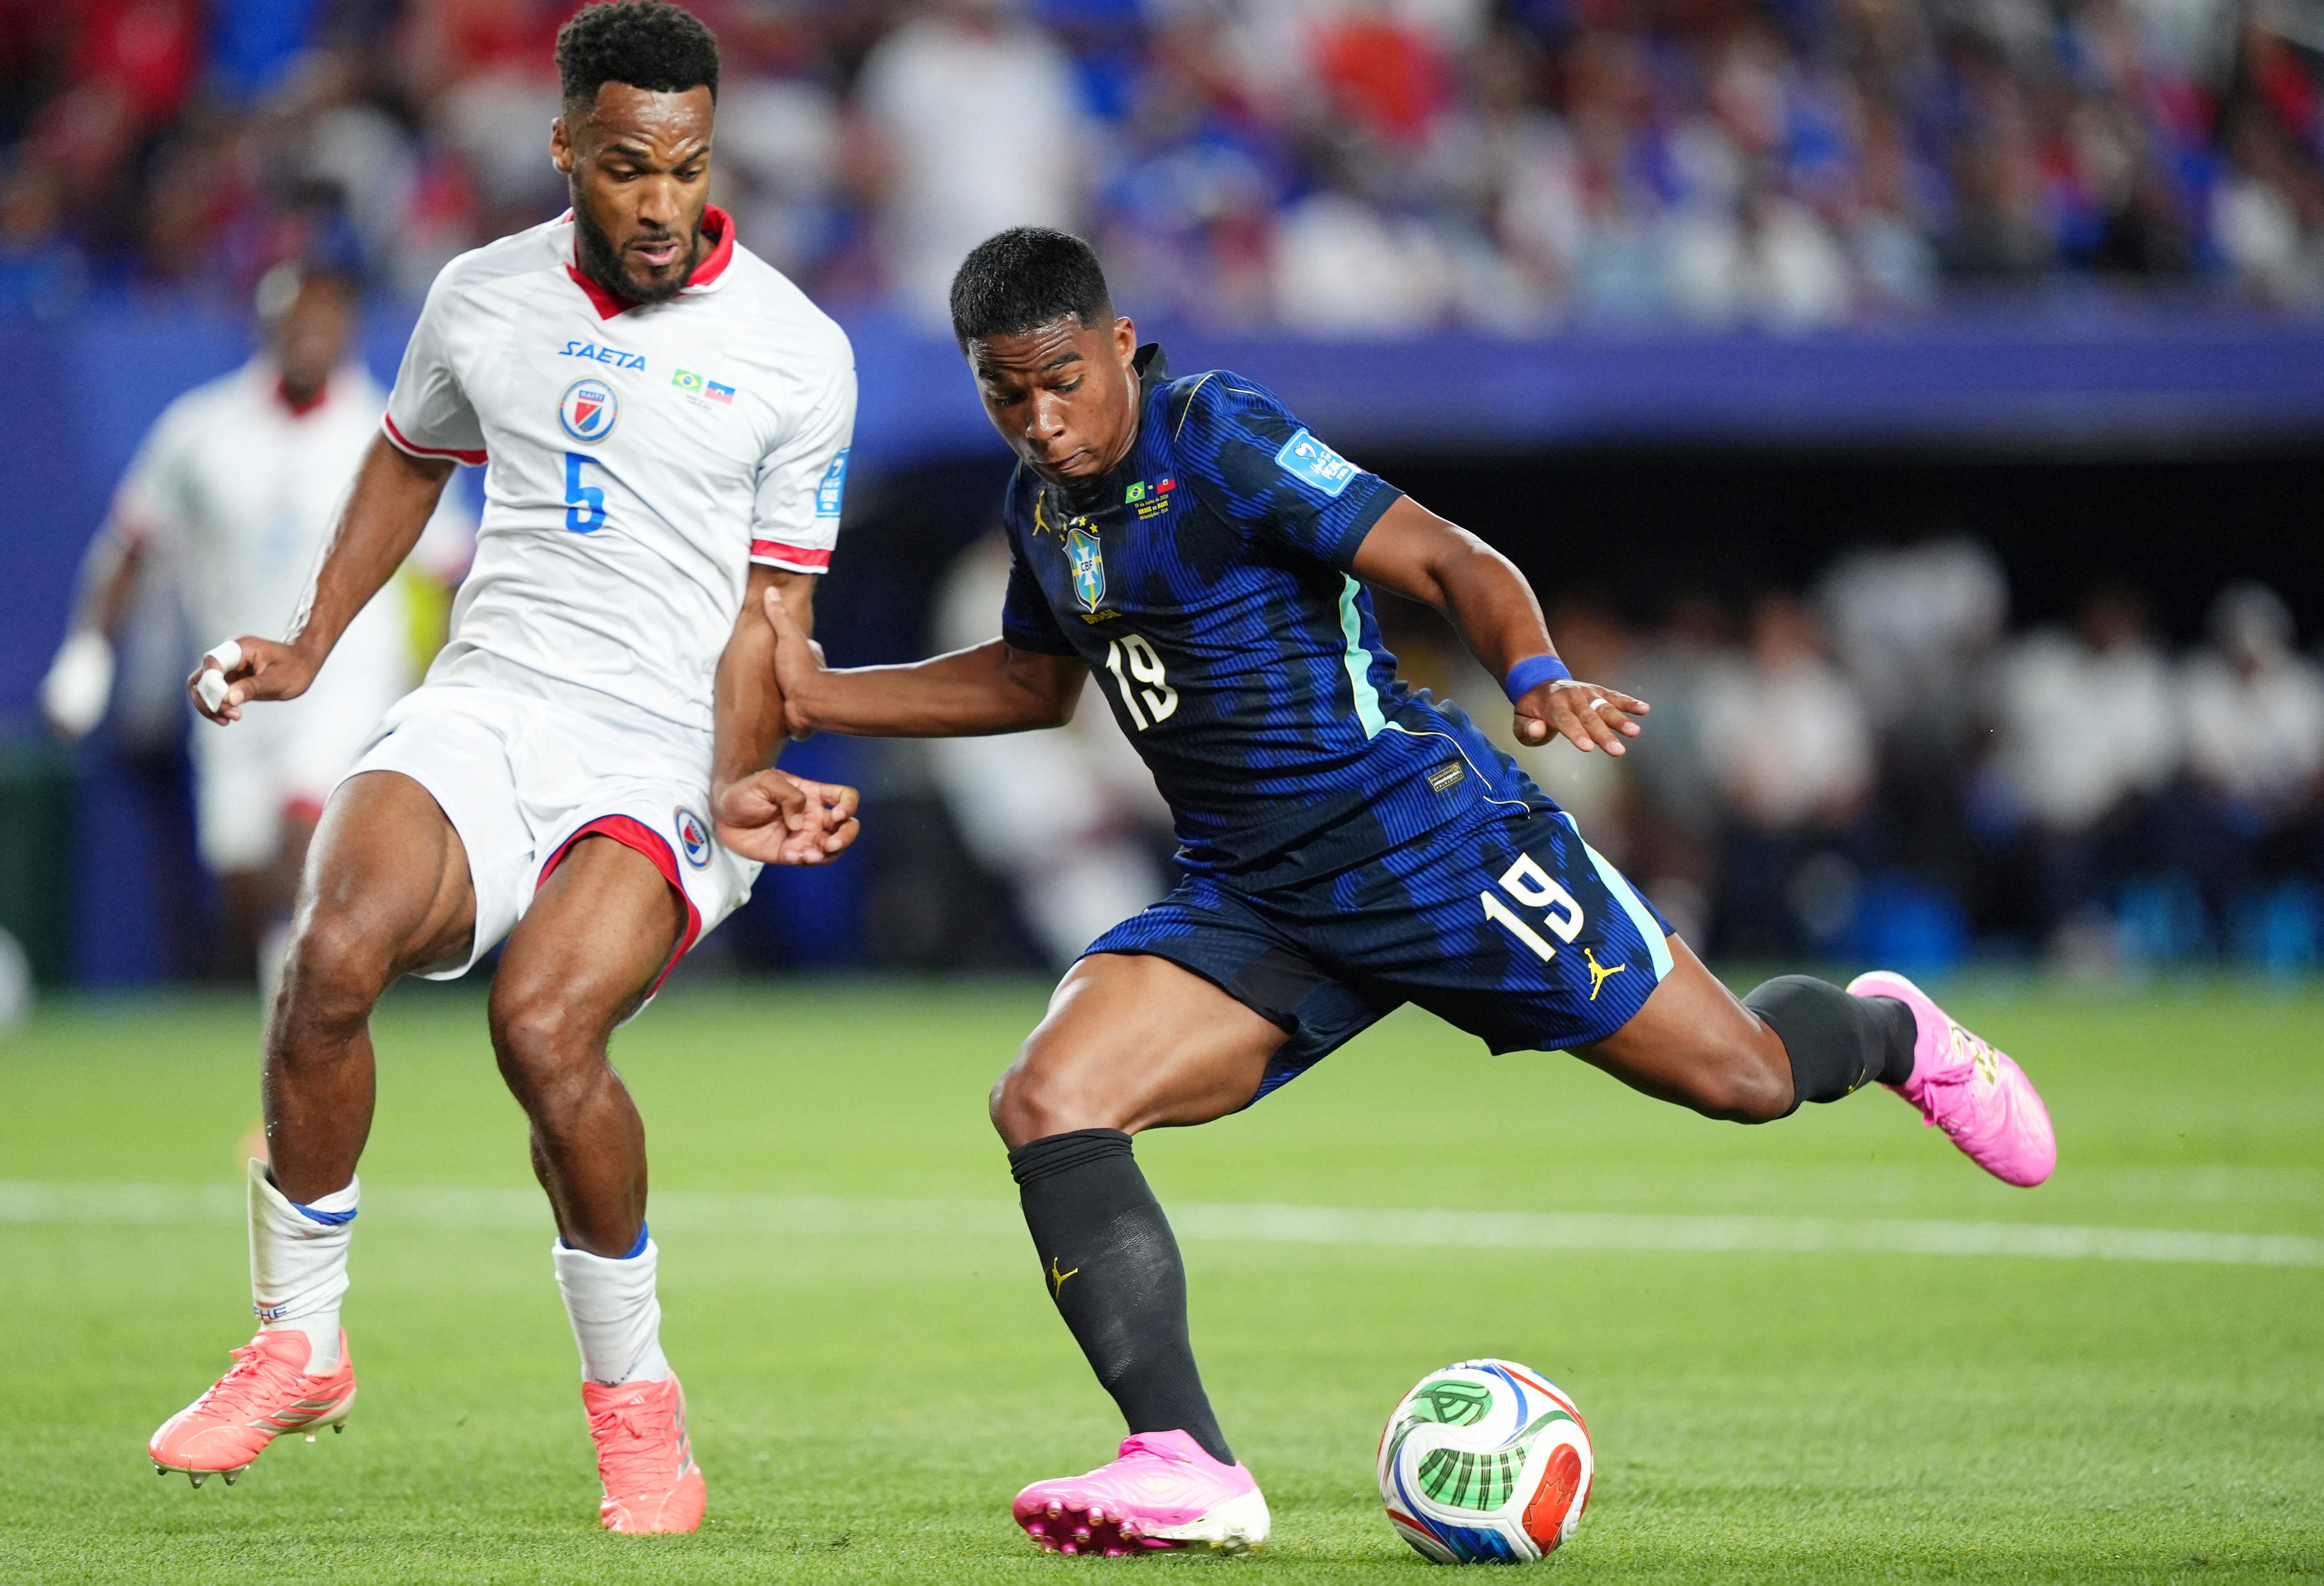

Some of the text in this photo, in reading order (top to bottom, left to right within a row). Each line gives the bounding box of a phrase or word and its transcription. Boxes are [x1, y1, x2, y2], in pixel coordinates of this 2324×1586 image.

[557, 340, 646, 371] SAETA
[565, 452, 606, 534] 5
[1080, 560, 1093, 571] CBF
[1080, 609, 1122, 625] BRASIL
[1105, 633, 1178, 731] 19
[1479, 851, 1584, 963] 19
